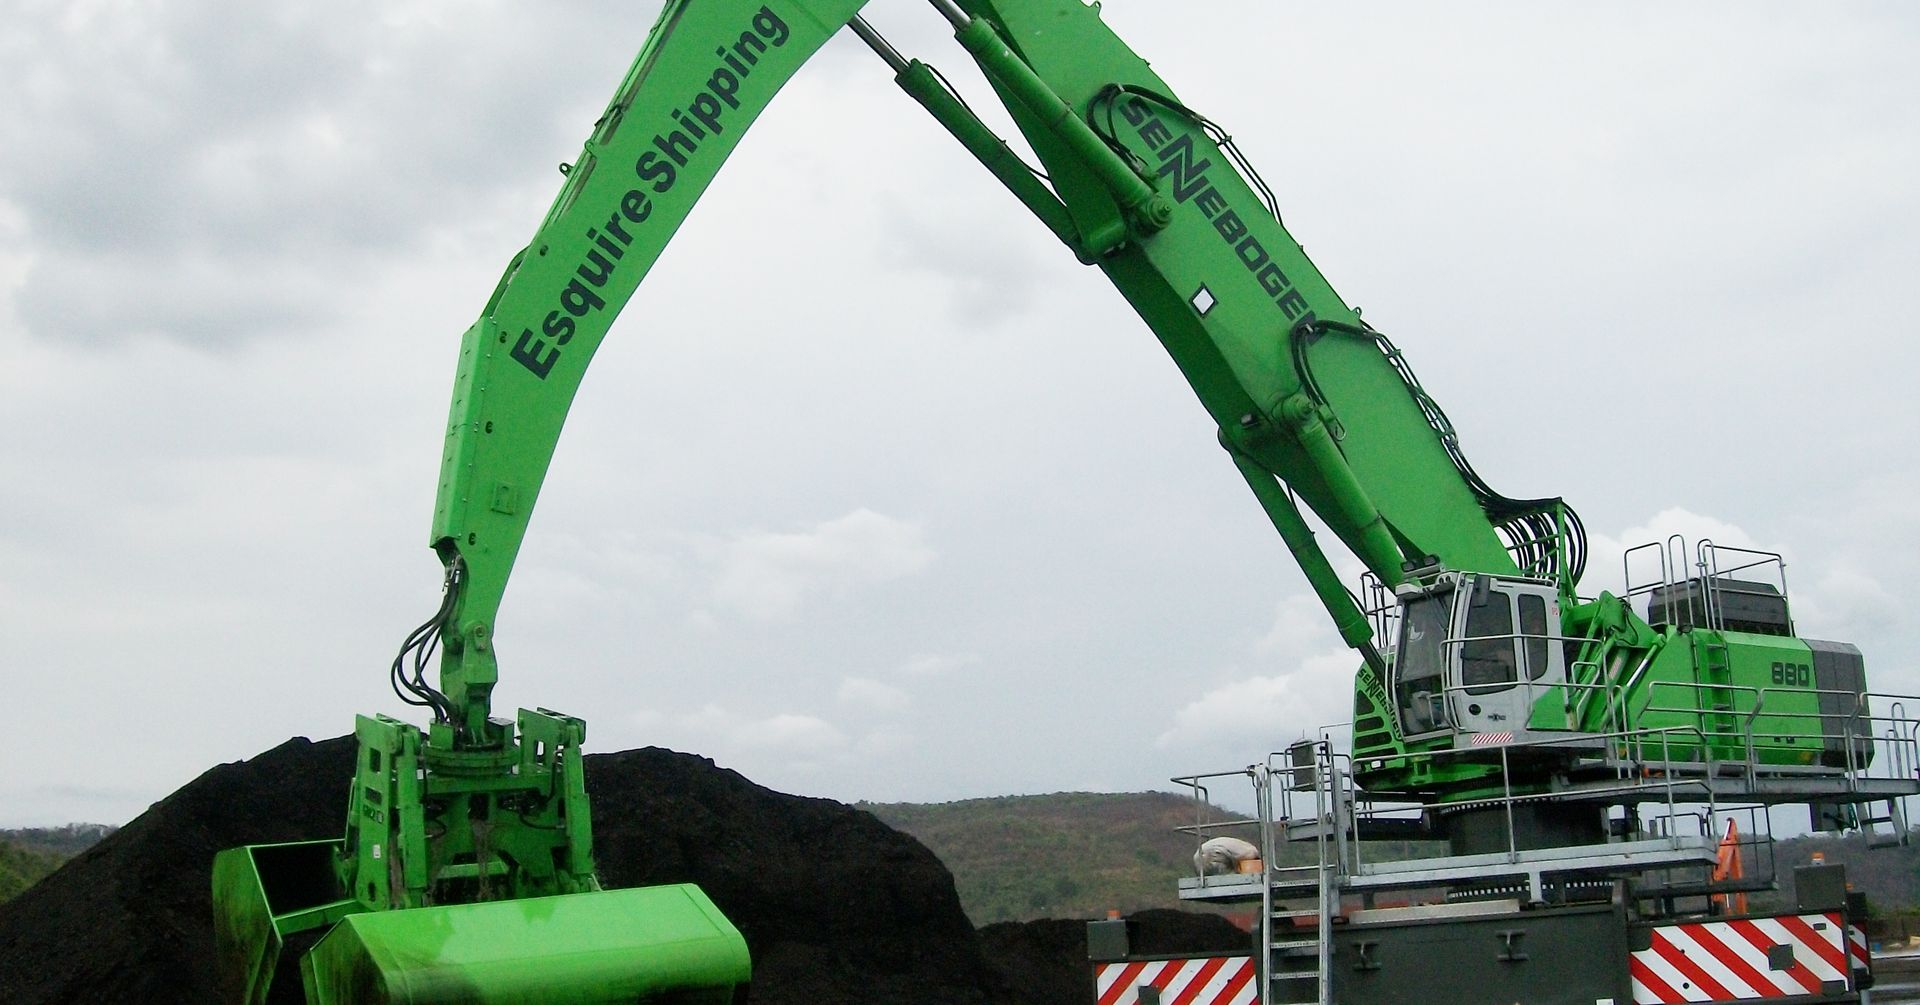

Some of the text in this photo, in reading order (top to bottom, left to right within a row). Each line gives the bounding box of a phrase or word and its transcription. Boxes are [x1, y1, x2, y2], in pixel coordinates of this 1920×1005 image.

[509, 5, 790, 381] Esquire Shipping
[1771, 661, 1810, 687] 880
